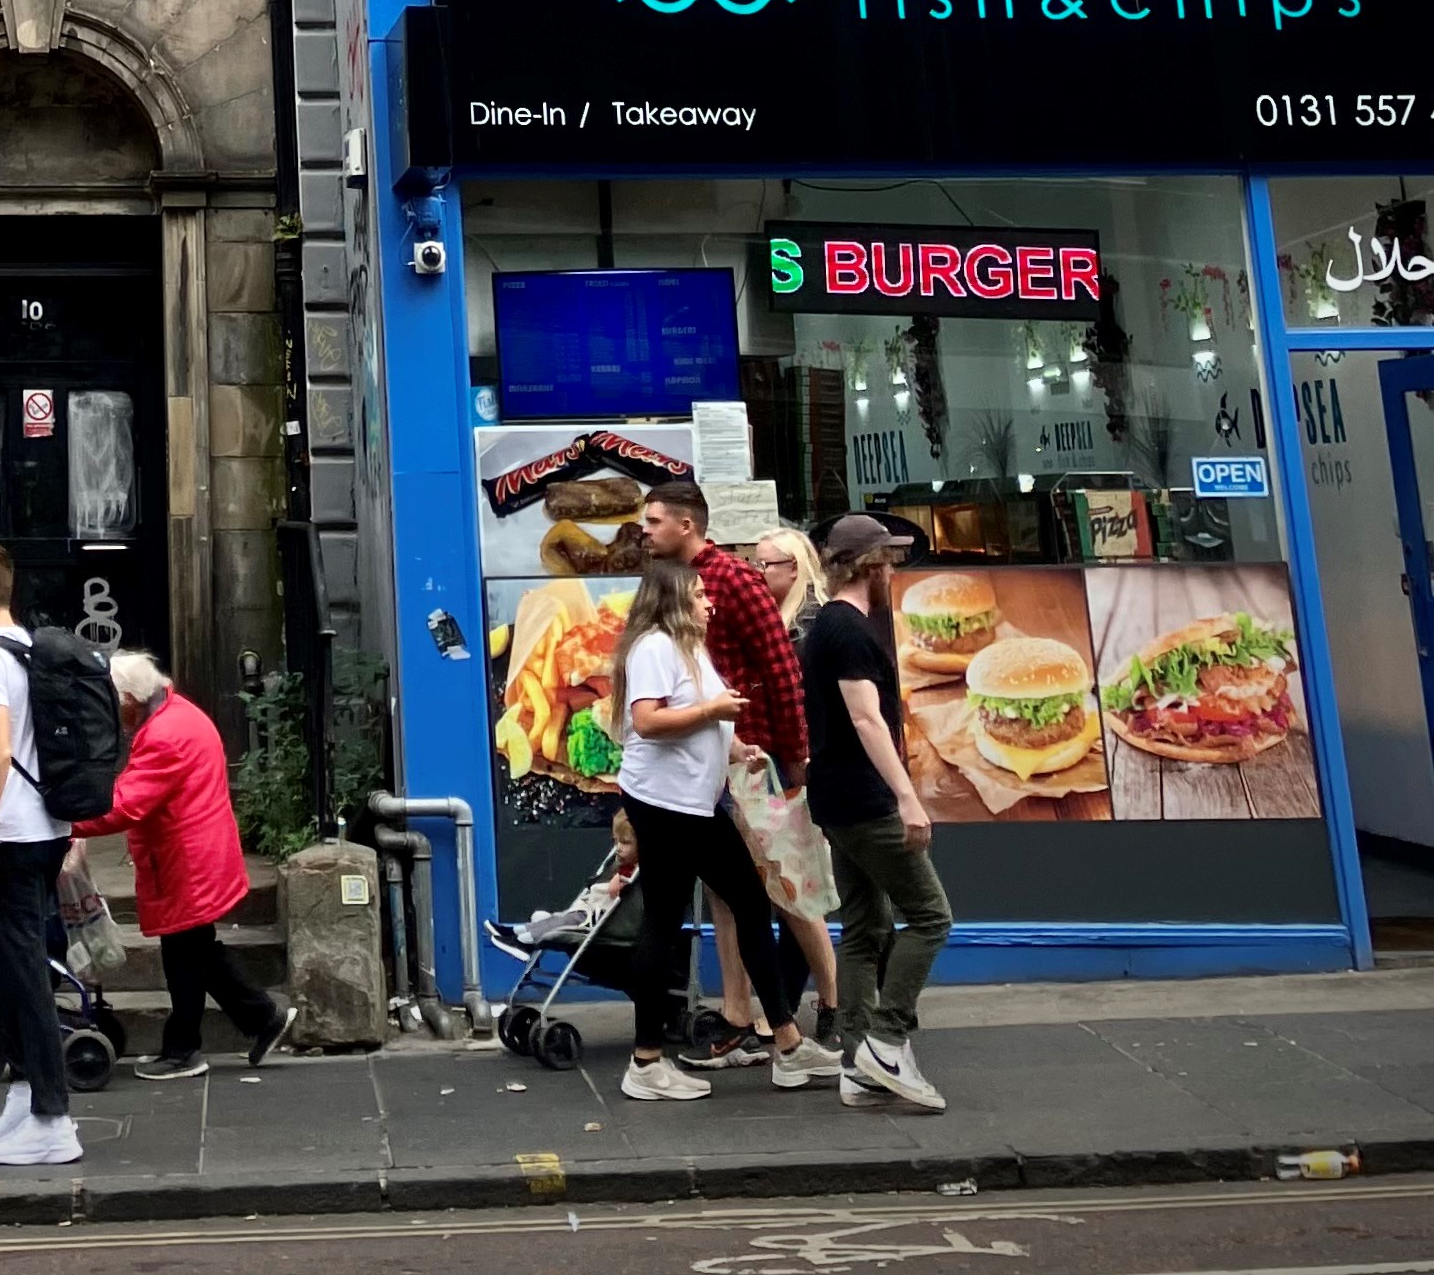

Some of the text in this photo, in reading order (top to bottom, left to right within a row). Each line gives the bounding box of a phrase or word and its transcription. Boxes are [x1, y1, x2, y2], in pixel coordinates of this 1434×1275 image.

[469, 100, 566, 127] Dine-In
[611, 100, 758, 132] Takeaway
[1256, 94, 1416, 127] 0131 557
[823, 239, 1100, 301] BURGER
[21, 299, 44, 321] 10
[1197, 463, 1263, 484] OPEN
